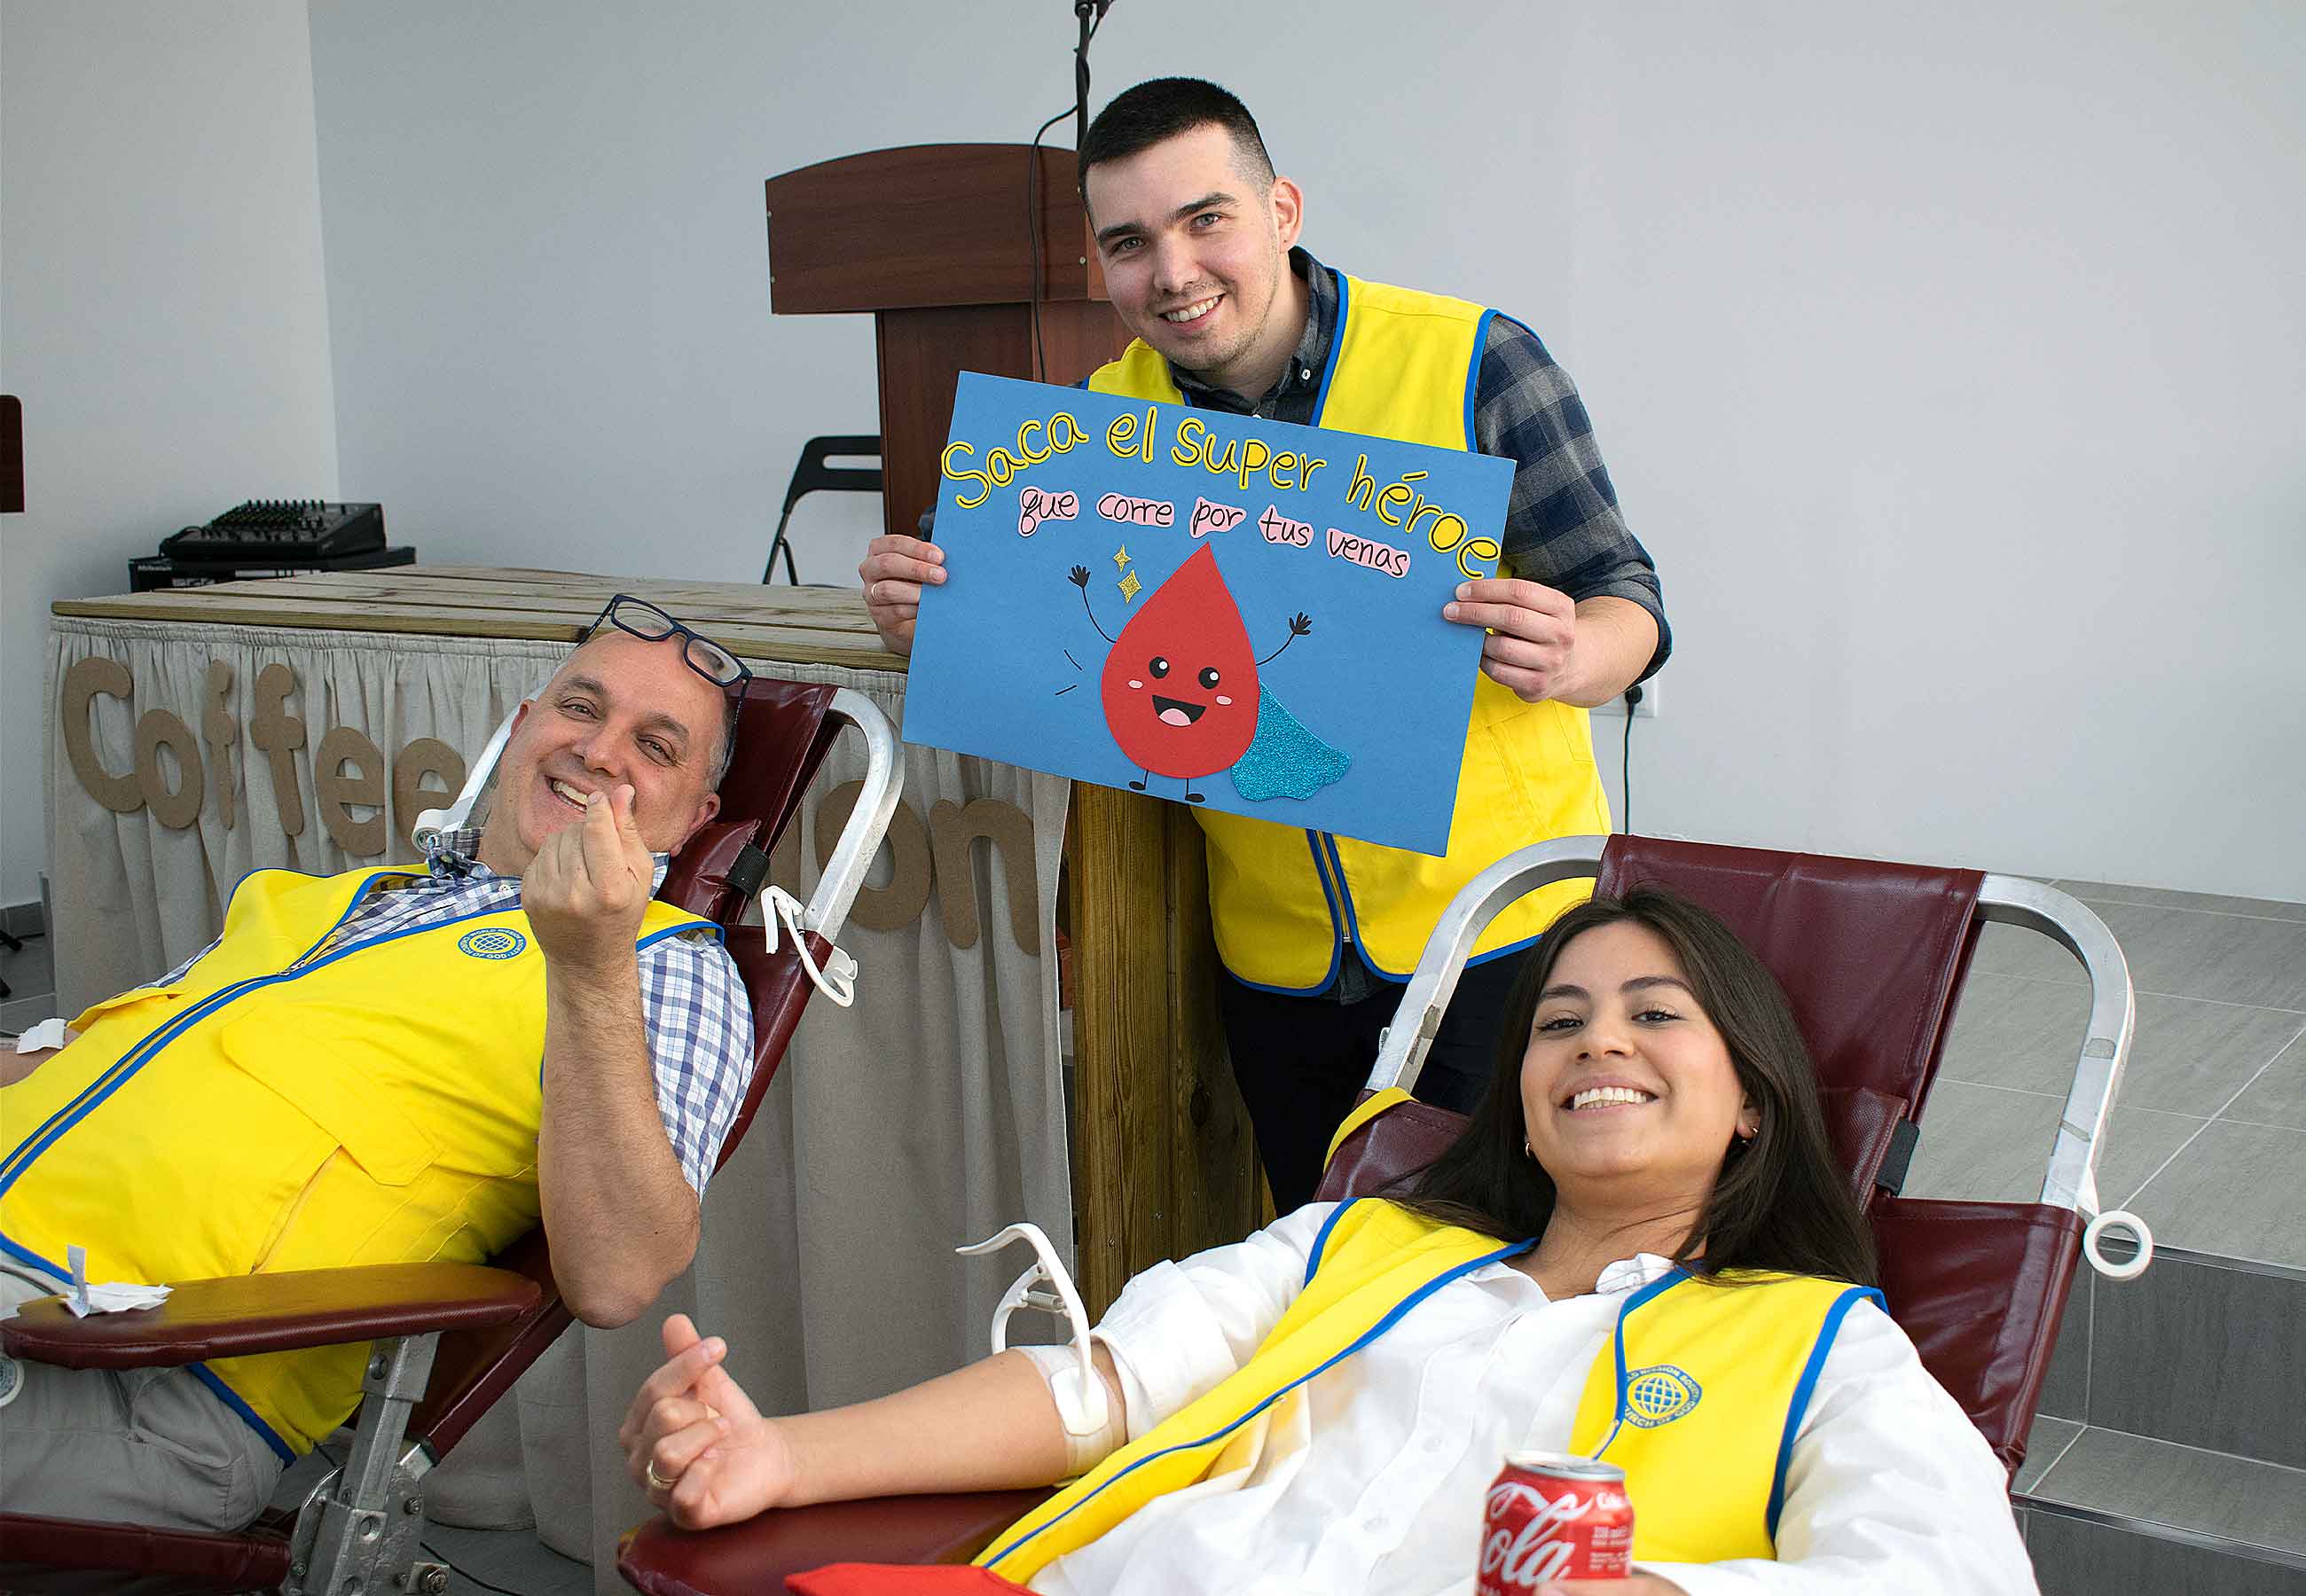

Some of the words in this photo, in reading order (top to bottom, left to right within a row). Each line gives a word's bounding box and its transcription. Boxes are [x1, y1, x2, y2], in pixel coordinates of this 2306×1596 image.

[940, 411, 1089, 509] Saca
[1105, 405, 1157, 463] el
[1171, 416, 1328, 491] super
[1346, 454, 1501, 579] héroe
[1098, 494, 1173, 526] corre
[1192, 501, 1243, 536] por
[1260, 507, 1310, 546] tus
[1329, 531, 1408, 576] venas
[63, 656, 467, 857] Coffee
[1624, 1404, 1655, 1427] URCH
